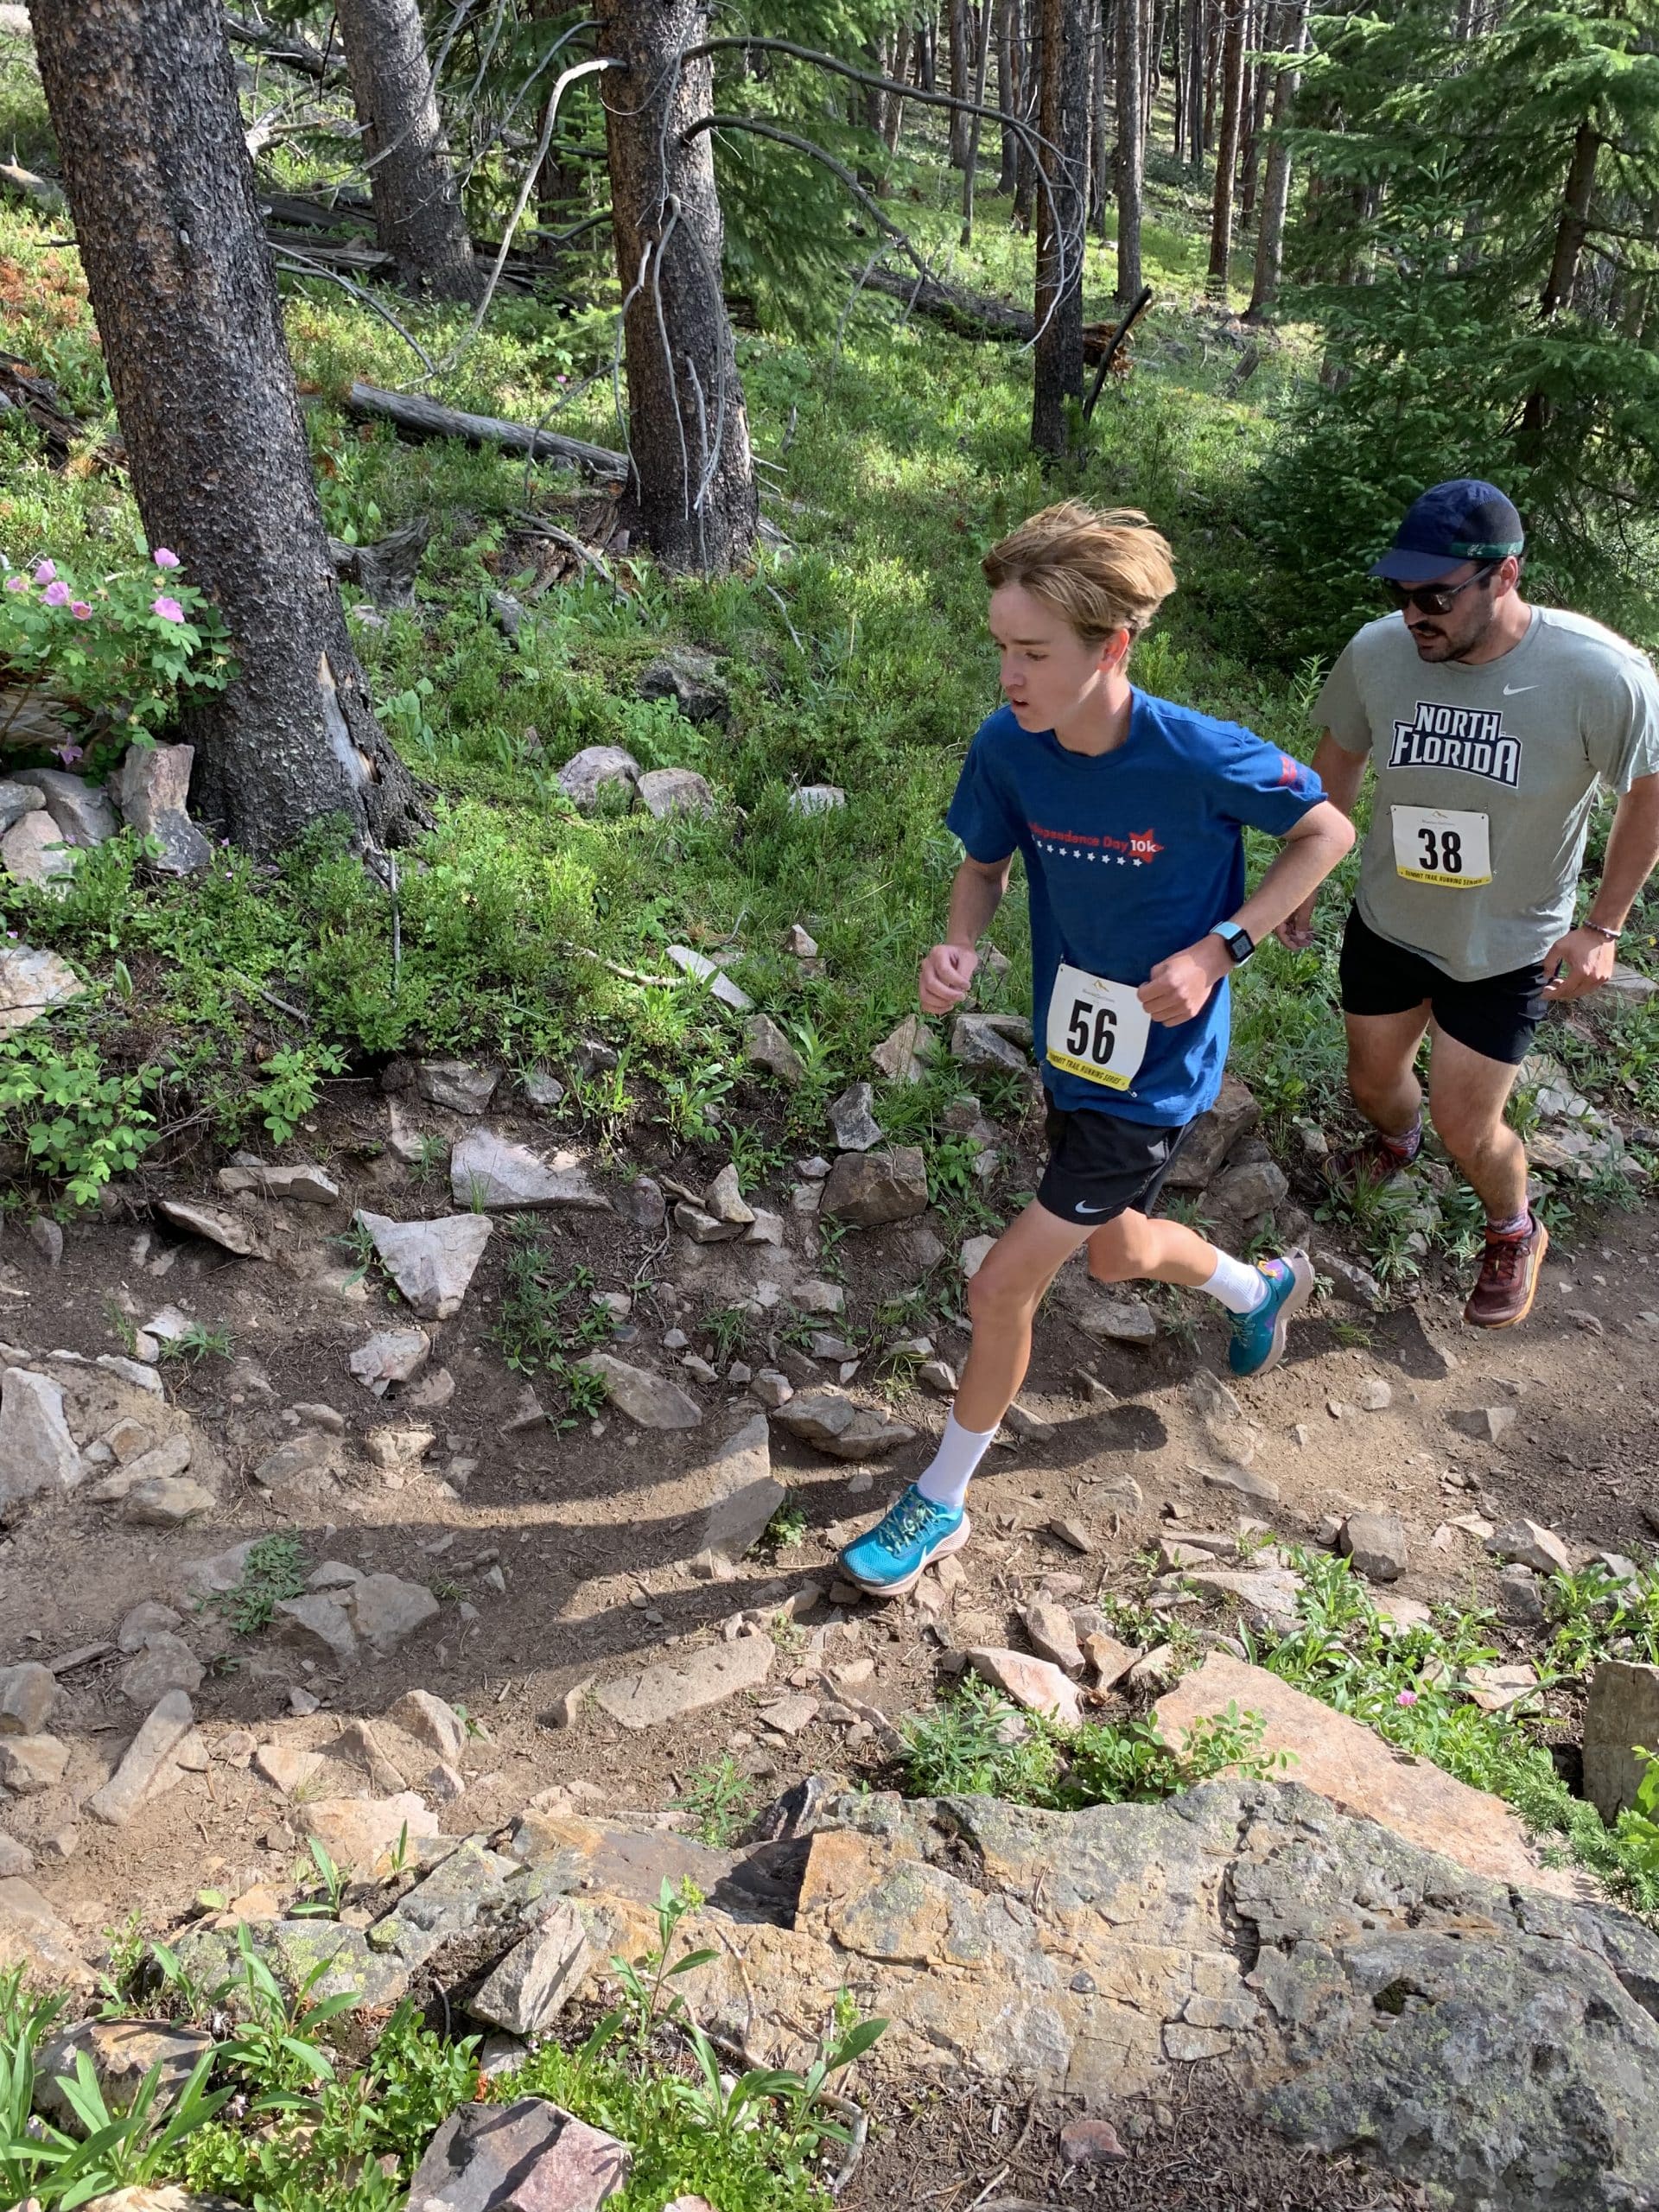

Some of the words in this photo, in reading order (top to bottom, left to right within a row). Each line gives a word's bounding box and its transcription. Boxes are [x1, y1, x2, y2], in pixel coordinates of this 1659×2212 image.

[1414, 704, 1500, 741] NORTH
[1390, 723, 1519, 784] FLORIDA
[1029, 823, 1099, 846] dependence
[1103, 835, 1128, 853] Day
[1130, 838, 1158, 854] 10k
[1417, 828, 1463, 874] 38
[1439, 875, 1462, 885] RUNNING
[1066, 998, 1118, 1065] 56
[1066, 1059, 1079, 1071] TRAIL
[1080, 1065, 1104, 1079] RUNNING
[1103, 1074, 1122, 1084] SERIES
